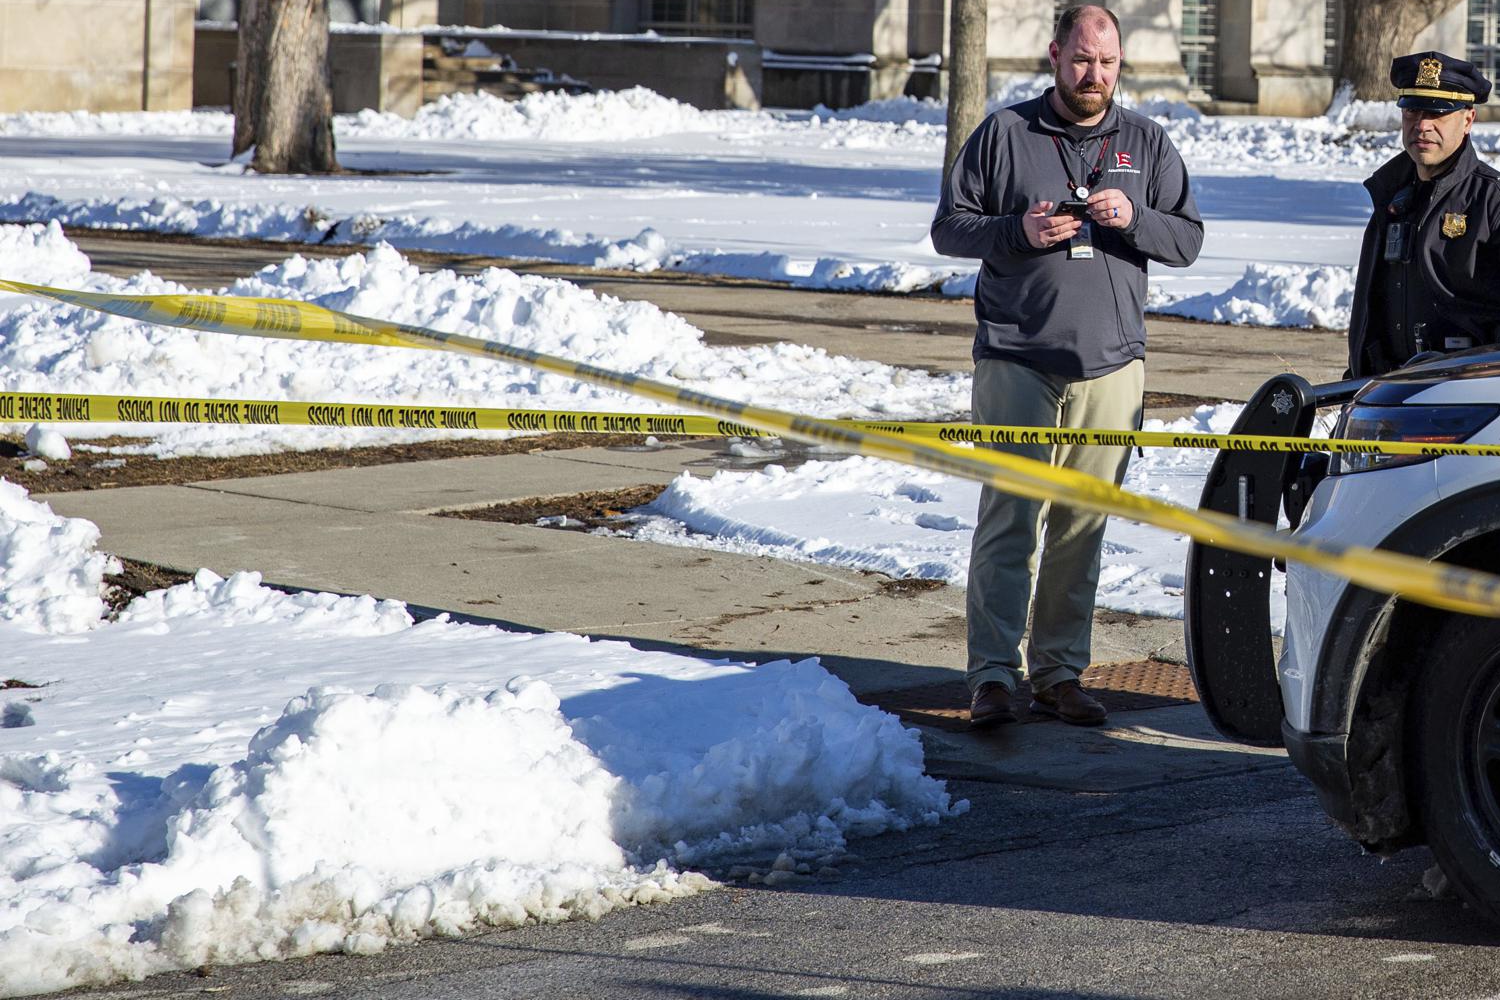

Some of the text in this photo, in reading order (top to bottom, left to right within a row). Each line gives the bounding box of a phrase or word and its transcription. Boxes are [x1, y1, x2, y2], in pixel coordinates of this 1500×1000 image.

[18, 397, 52, 420] SCENE
[57, 398, 90, 421] CRIME
[118, 400, 279, 424] CRIME SCENE DO NOT CROSS
